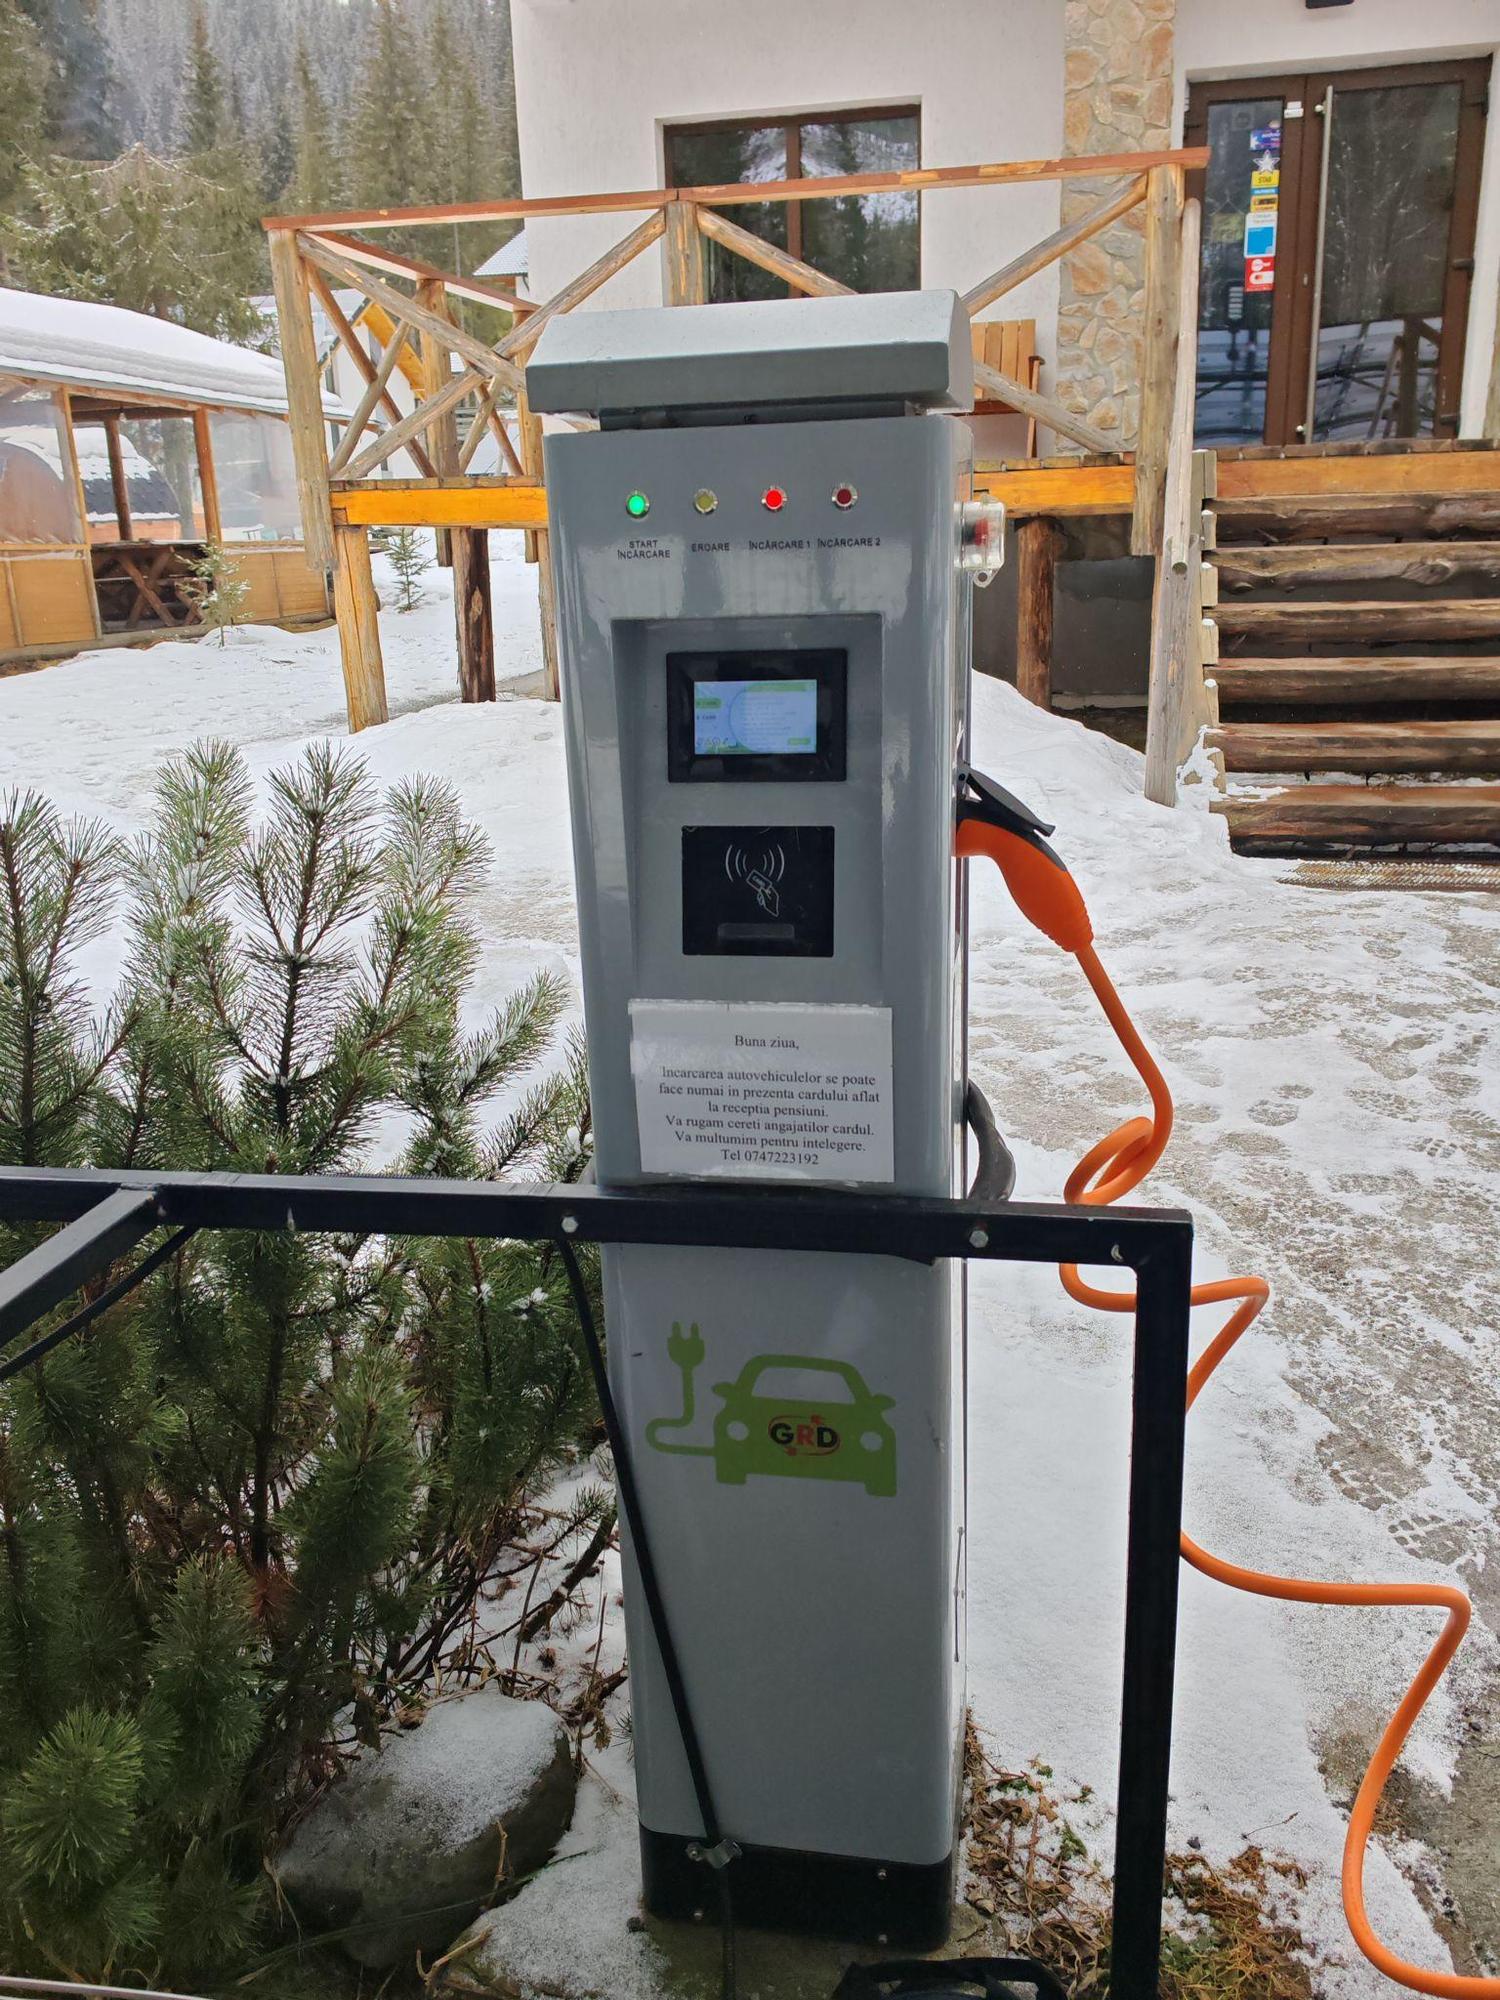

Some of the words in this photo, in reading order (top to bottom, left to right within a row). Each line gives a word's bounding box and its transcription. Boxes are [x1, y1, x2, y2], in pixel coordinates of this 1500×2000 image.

[629, 539, 659, 549] START
[691, 542, 730, 552] EROARE
[735, 1034, 767, 1047] Buna
[770, 1035, 800, 1050] ziua,
[662, 1066, 724, 1080] Incarcarea
[727, 1070, 822, 1084] autovehiculelor
[825, 1075, 839, 1084] se
[842, 1074, 876, 1087] poate
[659, 1082, 683, 1095] face
[687, 1084, 724, 1096] numai
[728, 1085, 740, 1097] in
[743, 1087, 794, 1100] prezenta
[798, 1088, 848, 1101] cardului
[852, 1090, 880, 1103] aflat
[708, 1101, 719, 1112] la
[723, 1103, 770, 1117] receptia
[774, 1105, 829, 1117] pensiuni.
[666, 1114, 682, 1126] Va
[686, 1118, 724, 1129] rugam
[727, 1119, 761, 1130] cereti
[764, 1120, 830, 1134] angajatilor
[832, 1124, 874, 1136] cardul.
[675, 1130, 692, 1142] Va
[696, 1132, 757, 1146] multumim
[760, 1137, 799, 1149] pentru
[803, 1138, 866, 1153] intelegere.
[721, 1149, 741, 1161] Tel
[744, 1150, 819, 1165] 0747223192
[769, 1421, 839, 1449] GRD
